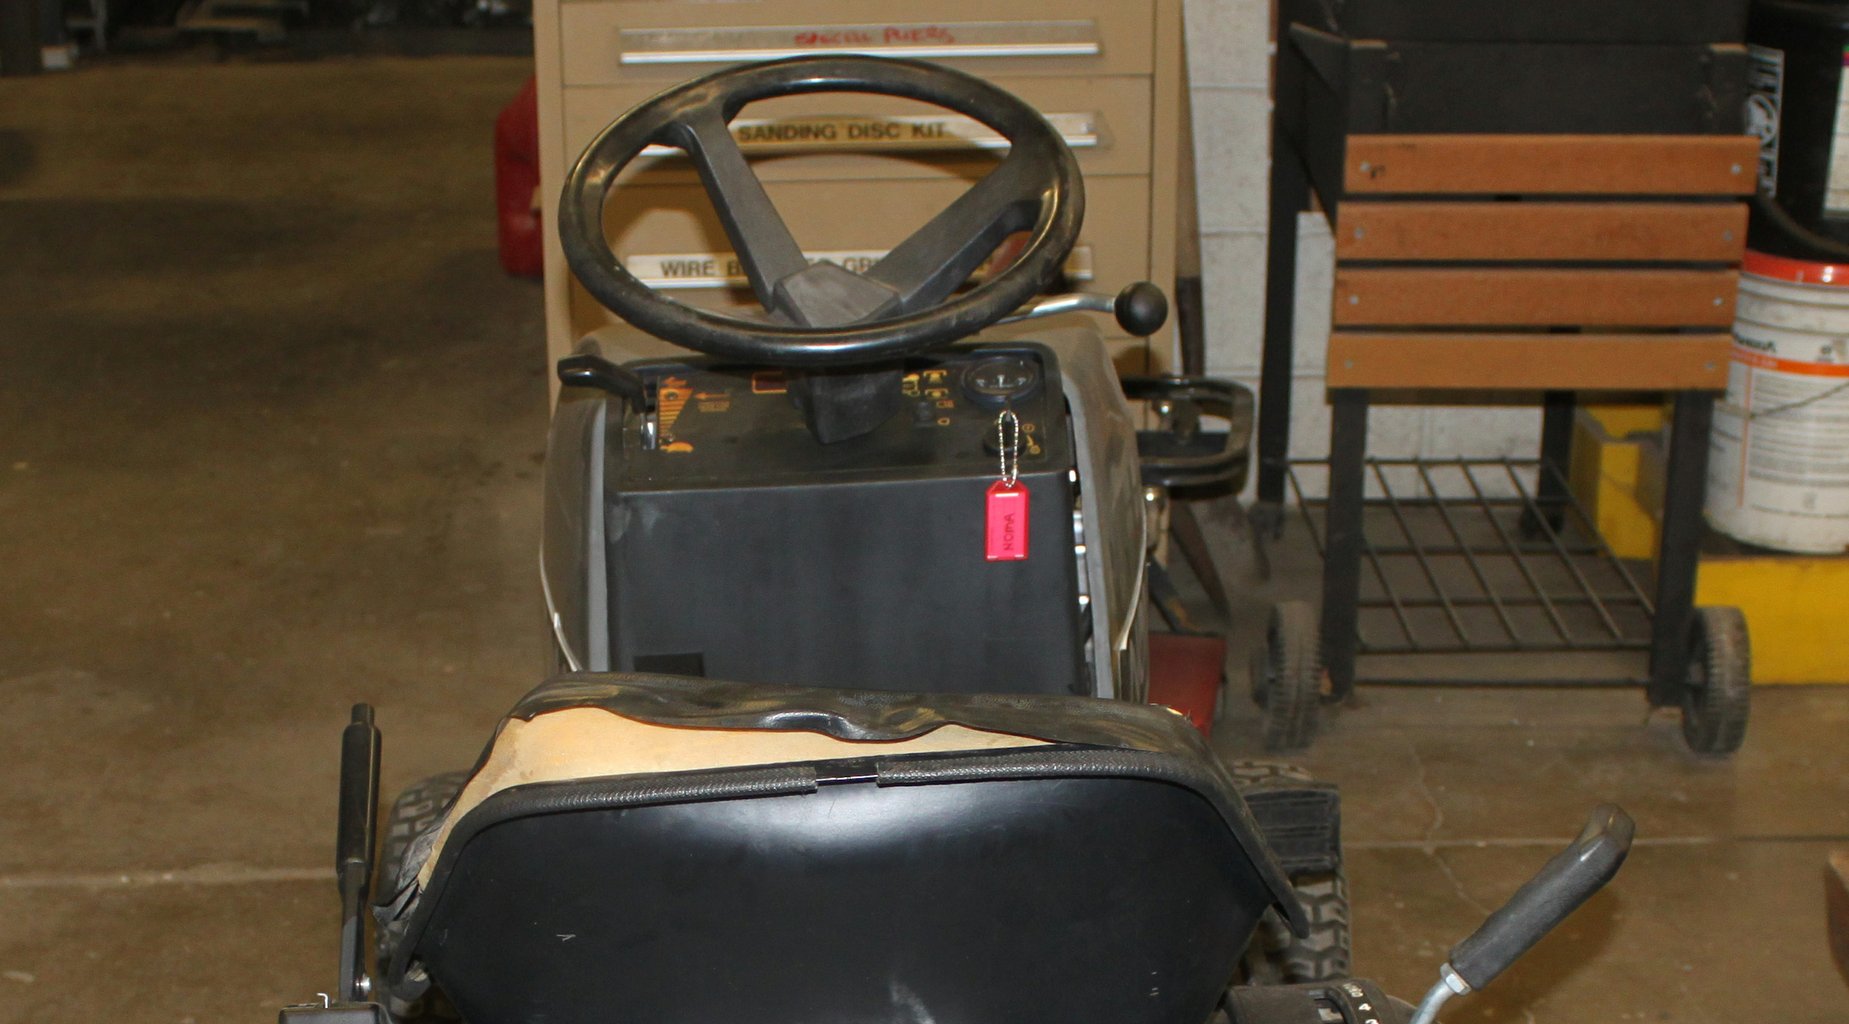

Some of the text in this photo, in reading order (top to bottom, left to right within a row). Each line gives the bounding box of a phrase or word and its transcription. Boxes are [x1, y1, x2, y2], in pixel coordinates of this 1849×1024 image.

[738, 121, 946, 141] SANDING DISC KIT
[660, 261, 716, 277] WIRE
